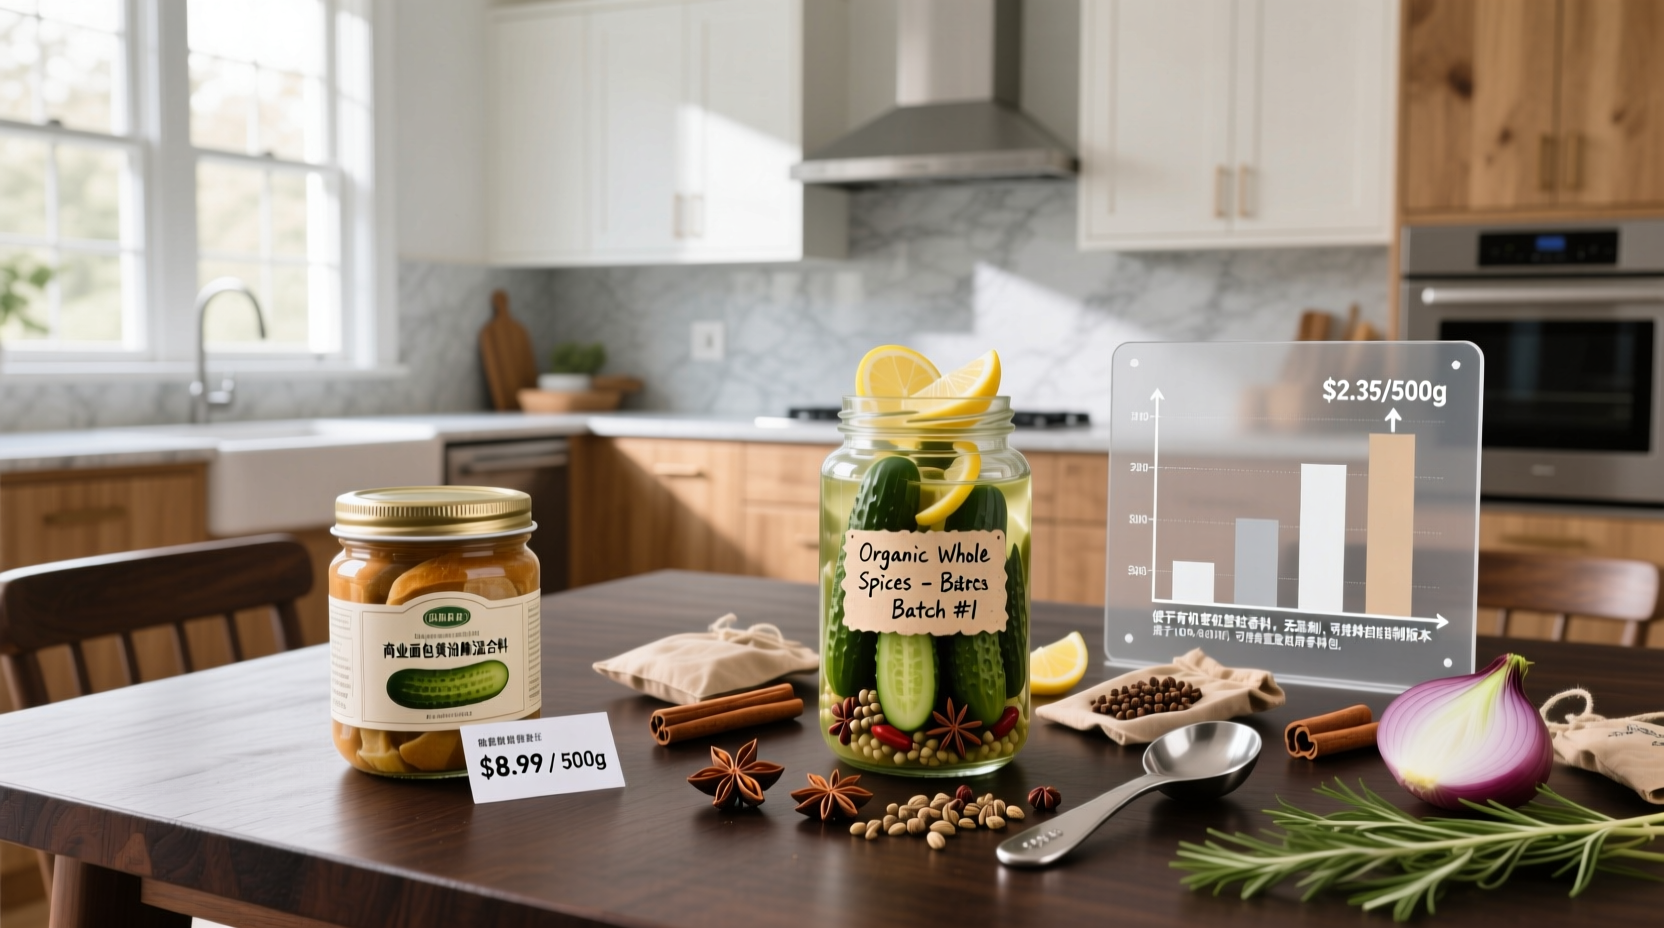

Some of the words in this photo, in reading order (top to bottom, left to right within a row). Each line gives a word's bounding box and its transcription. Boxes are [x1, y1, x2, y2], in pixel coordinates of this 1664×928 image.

[1322, 376, 1447, 407] $2.35/500g
[859, 542, 929, 571] Organic
[938, 542, 991, 564] Whole
[858, 571, 912, 598] Spices
[892, 599, 946, 620] Batch
[953, 599, 977, 620] #1
[479, 752, 543, 780] $8.99
[561, 750, 607, 771] 500g
